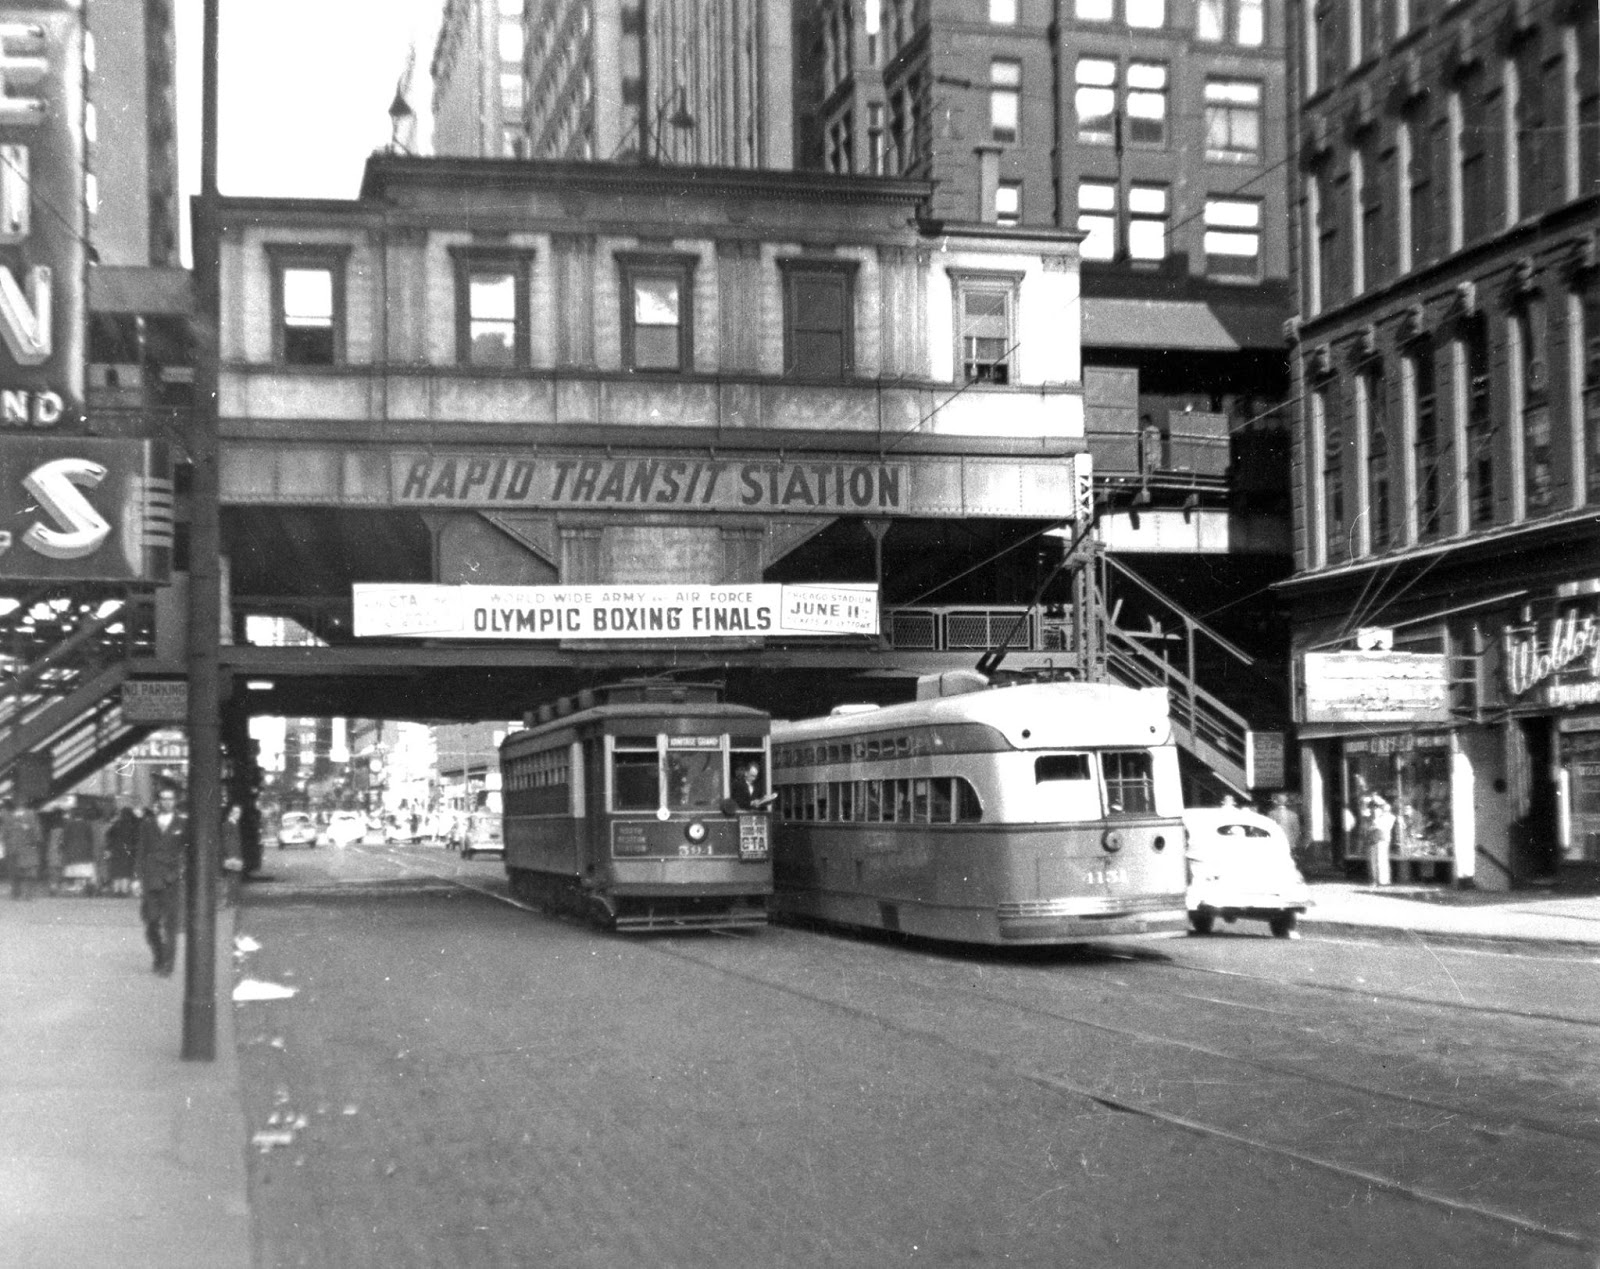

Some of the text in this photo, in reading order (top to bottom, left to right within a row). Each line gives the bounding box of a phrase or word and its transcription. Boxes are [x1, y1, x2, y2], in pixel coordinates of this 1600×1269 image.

[401, 458, 900, 508] RAPID TRANSIT STATION
[553, 592, 593, 604] WIDE
[602, 592, 646, 603] ARMY
[676, 592, 700, 603] AIR
[709, 592, 752, 603] FORCE
[787, 592, 828, 602] HICAGO
[790, 601, 841, 617] JUNE
[473, 606, 770, 633] OLYMPIC BOXING FINALS
[123, 683, 187, 696] NO PARKING
[742, 836, 767, 850] CTA
